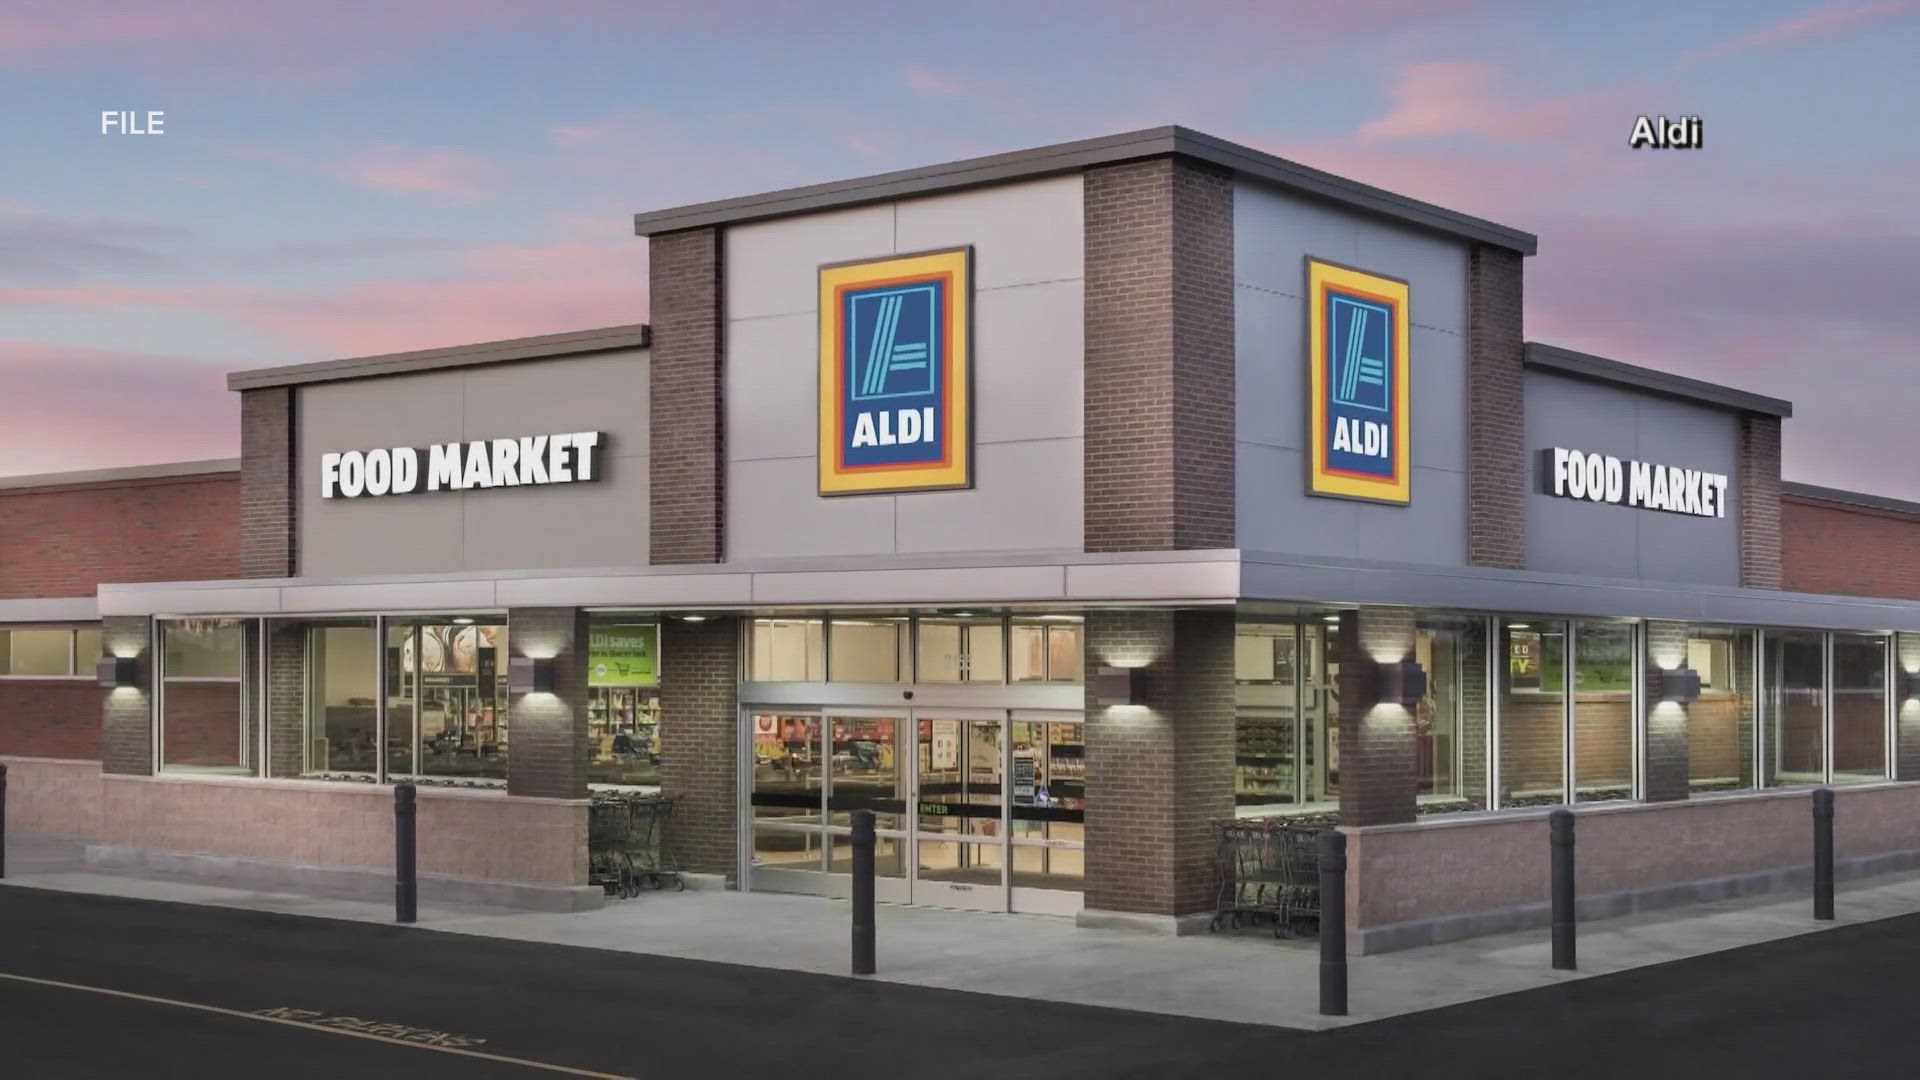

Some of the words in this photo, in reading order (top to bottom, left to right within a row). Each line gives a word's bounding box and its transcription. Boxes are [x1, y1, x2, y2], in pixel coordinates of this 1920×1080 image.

[851, 407, 934, 448] ALDI
[1333, 416, 1388, 458] ALDI
[321, 447, 418, 498] FOOD
[427, 431, 599, 491] MARKET
[1554, 447, 1623, 503] FOOD
[1628, 460, 1728, 518] MARKET
[609, 636, 645, 648] saves
[920, 803, 948, 814] ENTER
